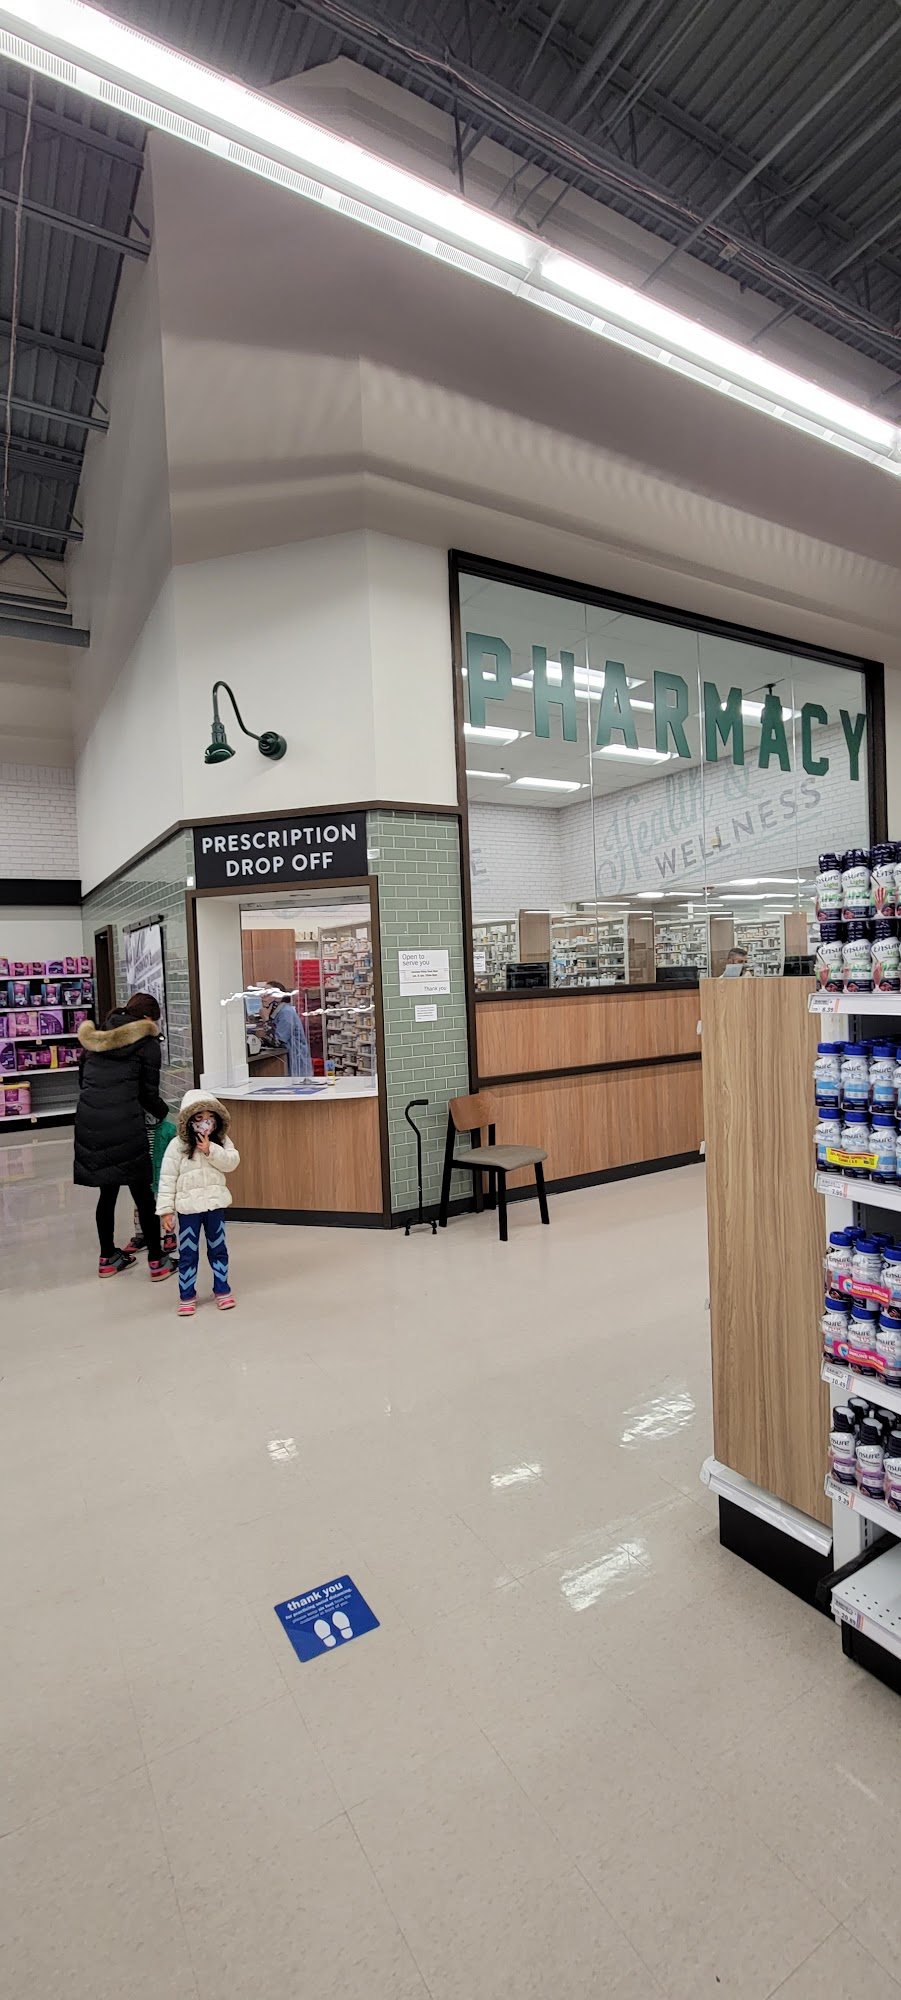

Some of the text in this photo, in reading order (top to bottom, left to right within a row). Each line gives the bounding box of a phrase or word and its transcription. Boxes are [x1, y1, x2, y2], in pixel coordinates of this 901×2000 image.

[466, 632, 866, 781] PHARMACY
[202, 824, 356, 854] PRESCRIPTION
[597, 768, 713, 895] Health
[655, 777, 821, 878] WELLNESS
[226, 852, 333, 877] DROP OFF
[873, 943, 900, 953] Ensur
[831, 1189, 843, 1197] 7.99
[832, 1378, 846, 1389] 10.49
[858, 1451, 881, 1459] nsure
[287, 1582, 344, 1611] thank you
